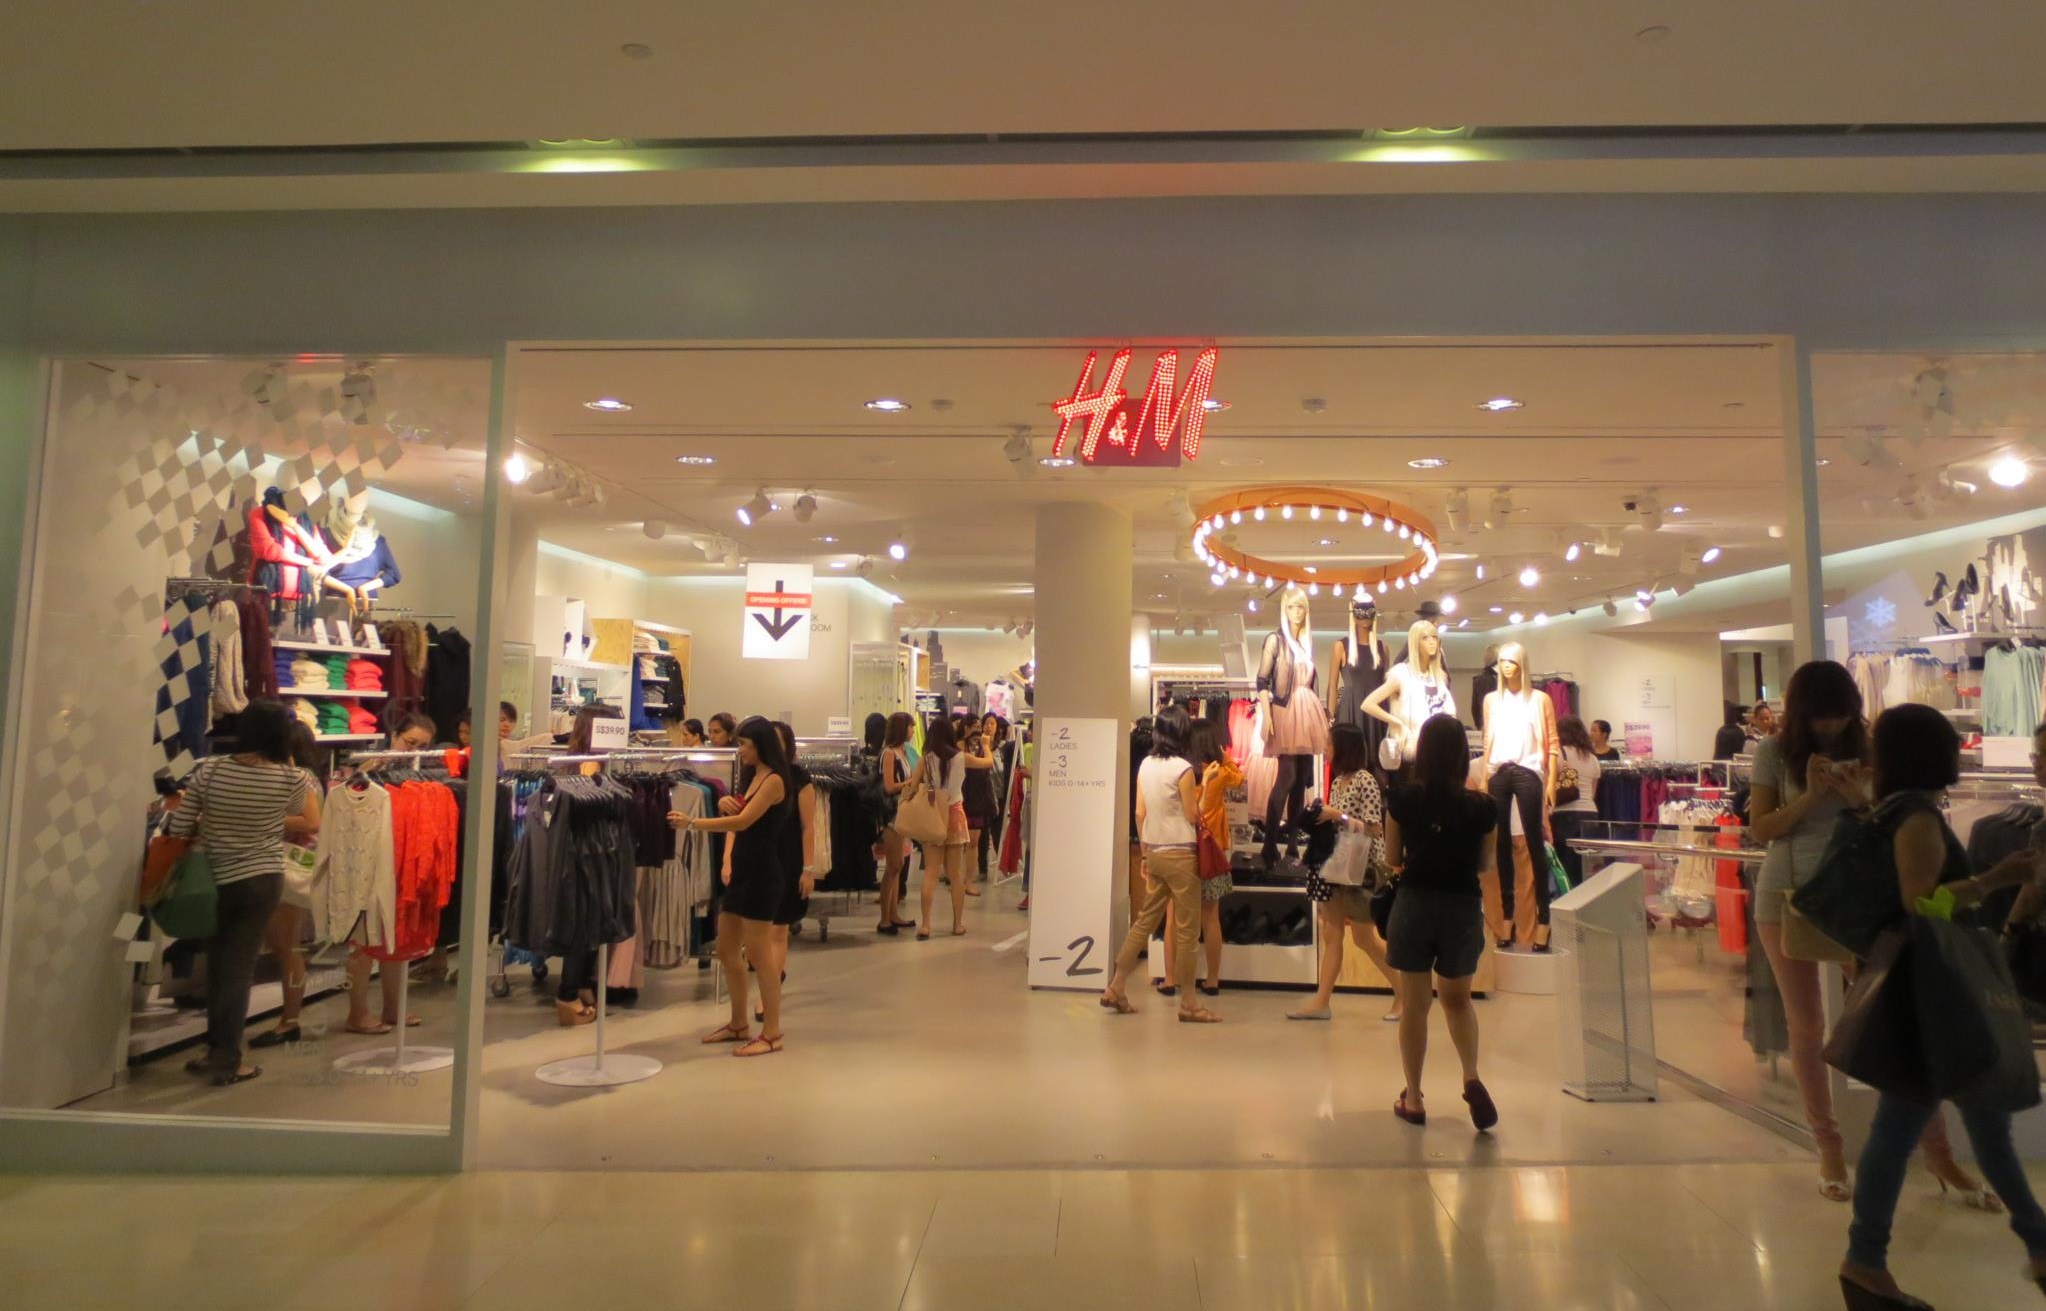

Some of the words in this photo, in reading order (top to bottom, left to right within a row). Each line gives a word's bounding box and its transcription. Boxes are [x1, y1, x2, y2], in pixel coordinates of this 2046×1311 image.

[1052, 347, 1218, 462] H&M
[810, 624, 831, 632] OOM
[595, 726, 625, 735] S$39.90
[1051, 727, 1071, 740] -2
[1049, 755, 1067, 768] -3
[1039, 935, 1104, 977] -2
